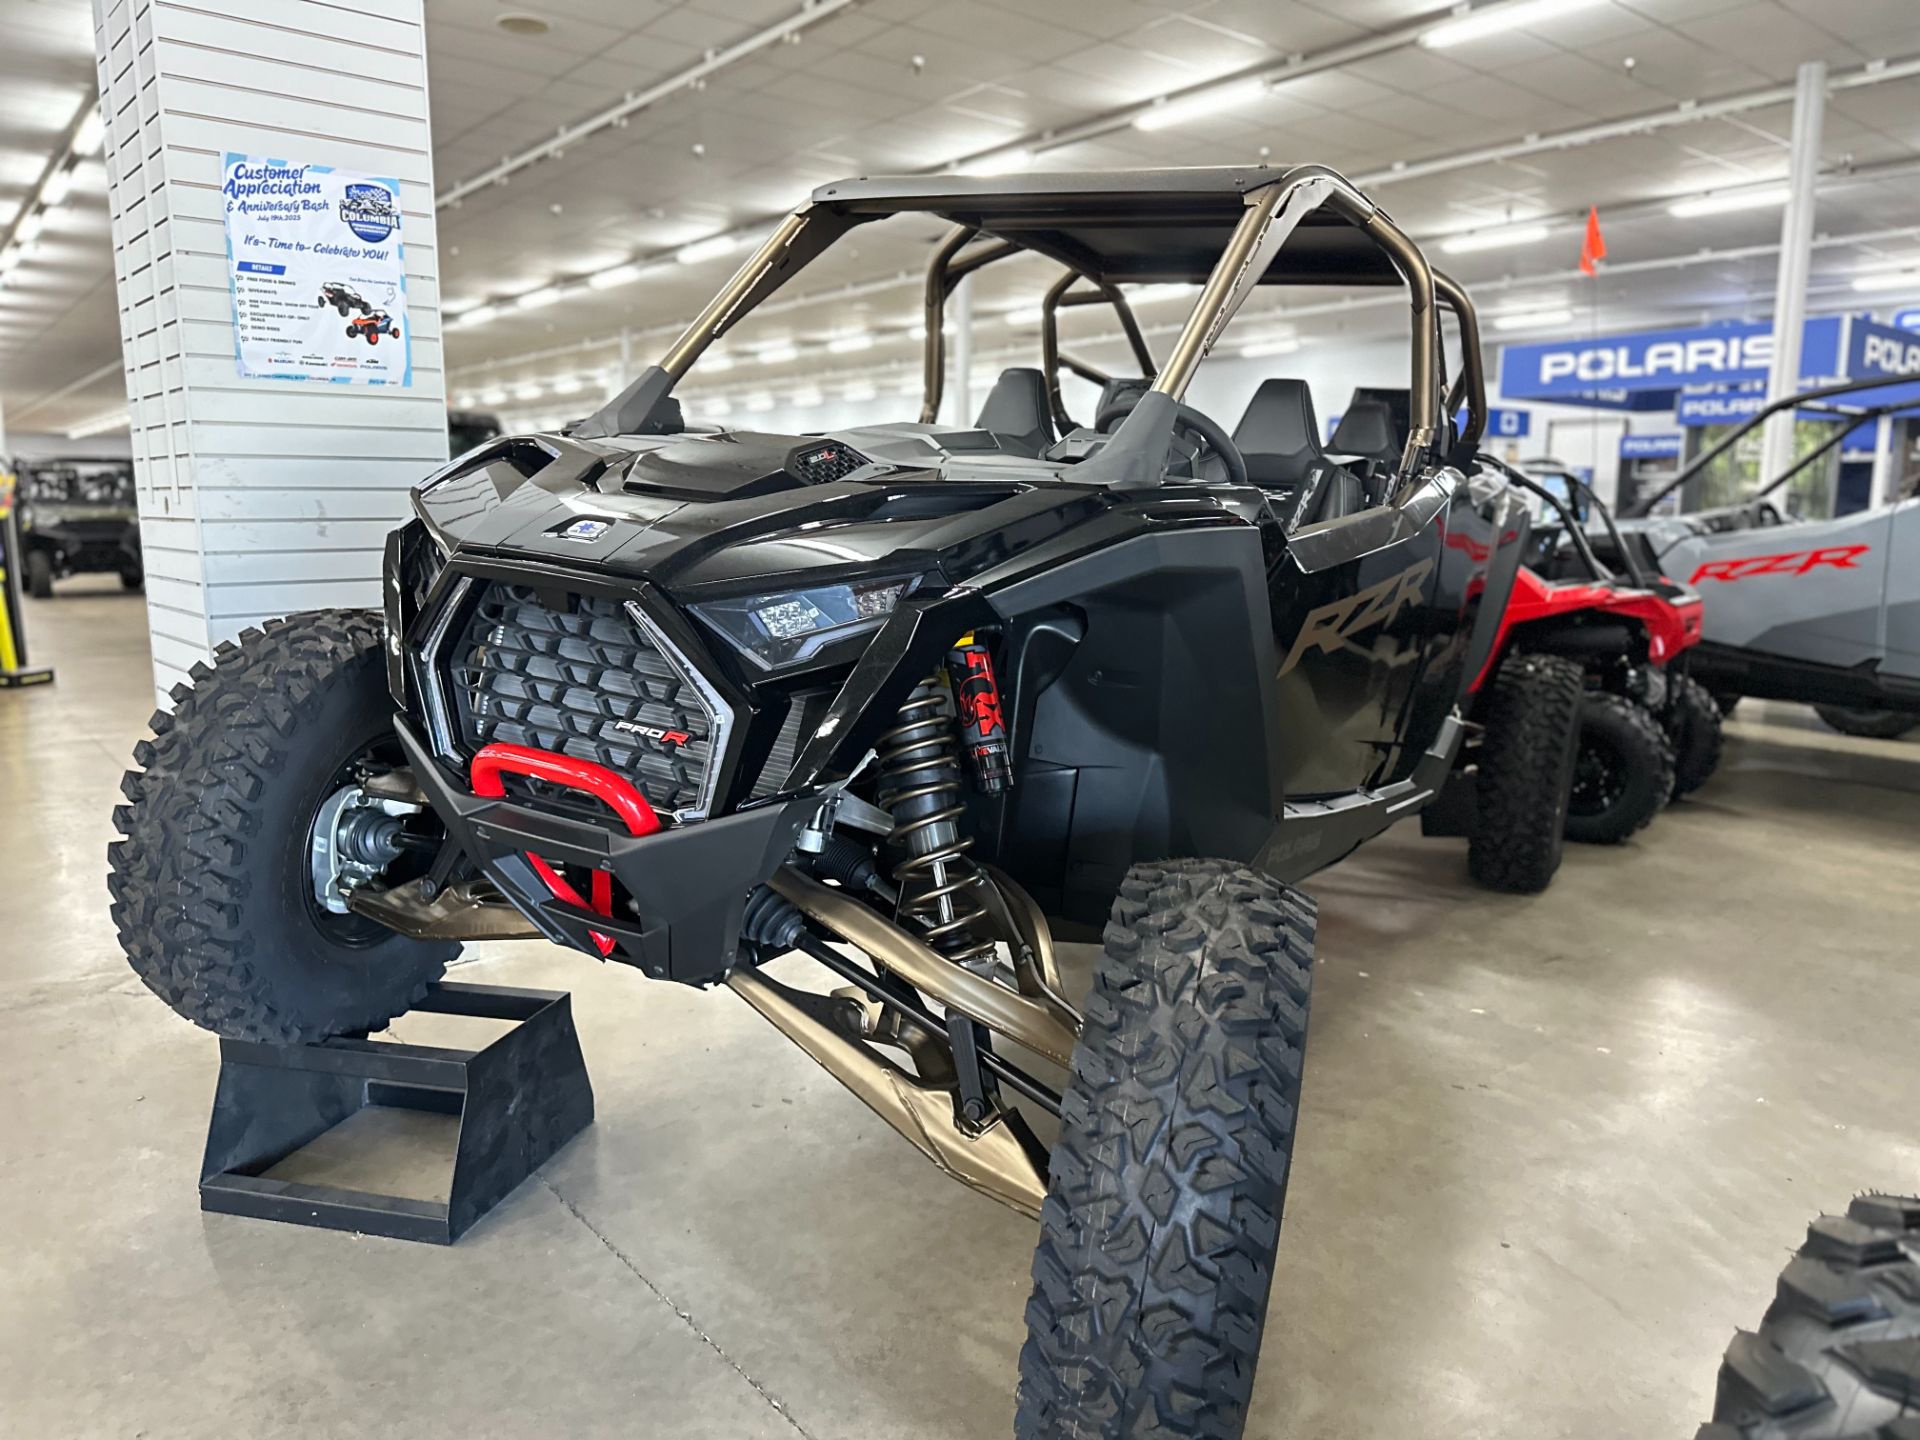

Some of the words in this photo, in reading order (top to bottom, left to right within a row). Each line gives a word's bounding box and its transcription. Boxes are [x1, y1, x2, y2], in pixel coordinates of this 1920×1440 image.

[234, 163, 310, 181] Customer
[223, 179, 321, 199] Appreciation
[238, 201, 300, 215] Anniversary
[300, 199, 330, 211] Bash
[341, 209, 399, 229] COLUMBIA
[268, 237, 293, 250] Time
[313, 242, 361, 259] Celebrate
[362, 249, 389, 261] YOU!
[1540, 334, 1775, 384] POLARIS
[1863, 334, 1920, 375] POLA
[1688, 544, 1870, 586] RZR
[1276, 557, 1434, 679] RZR
[615, 721, 666, 739] PRO
